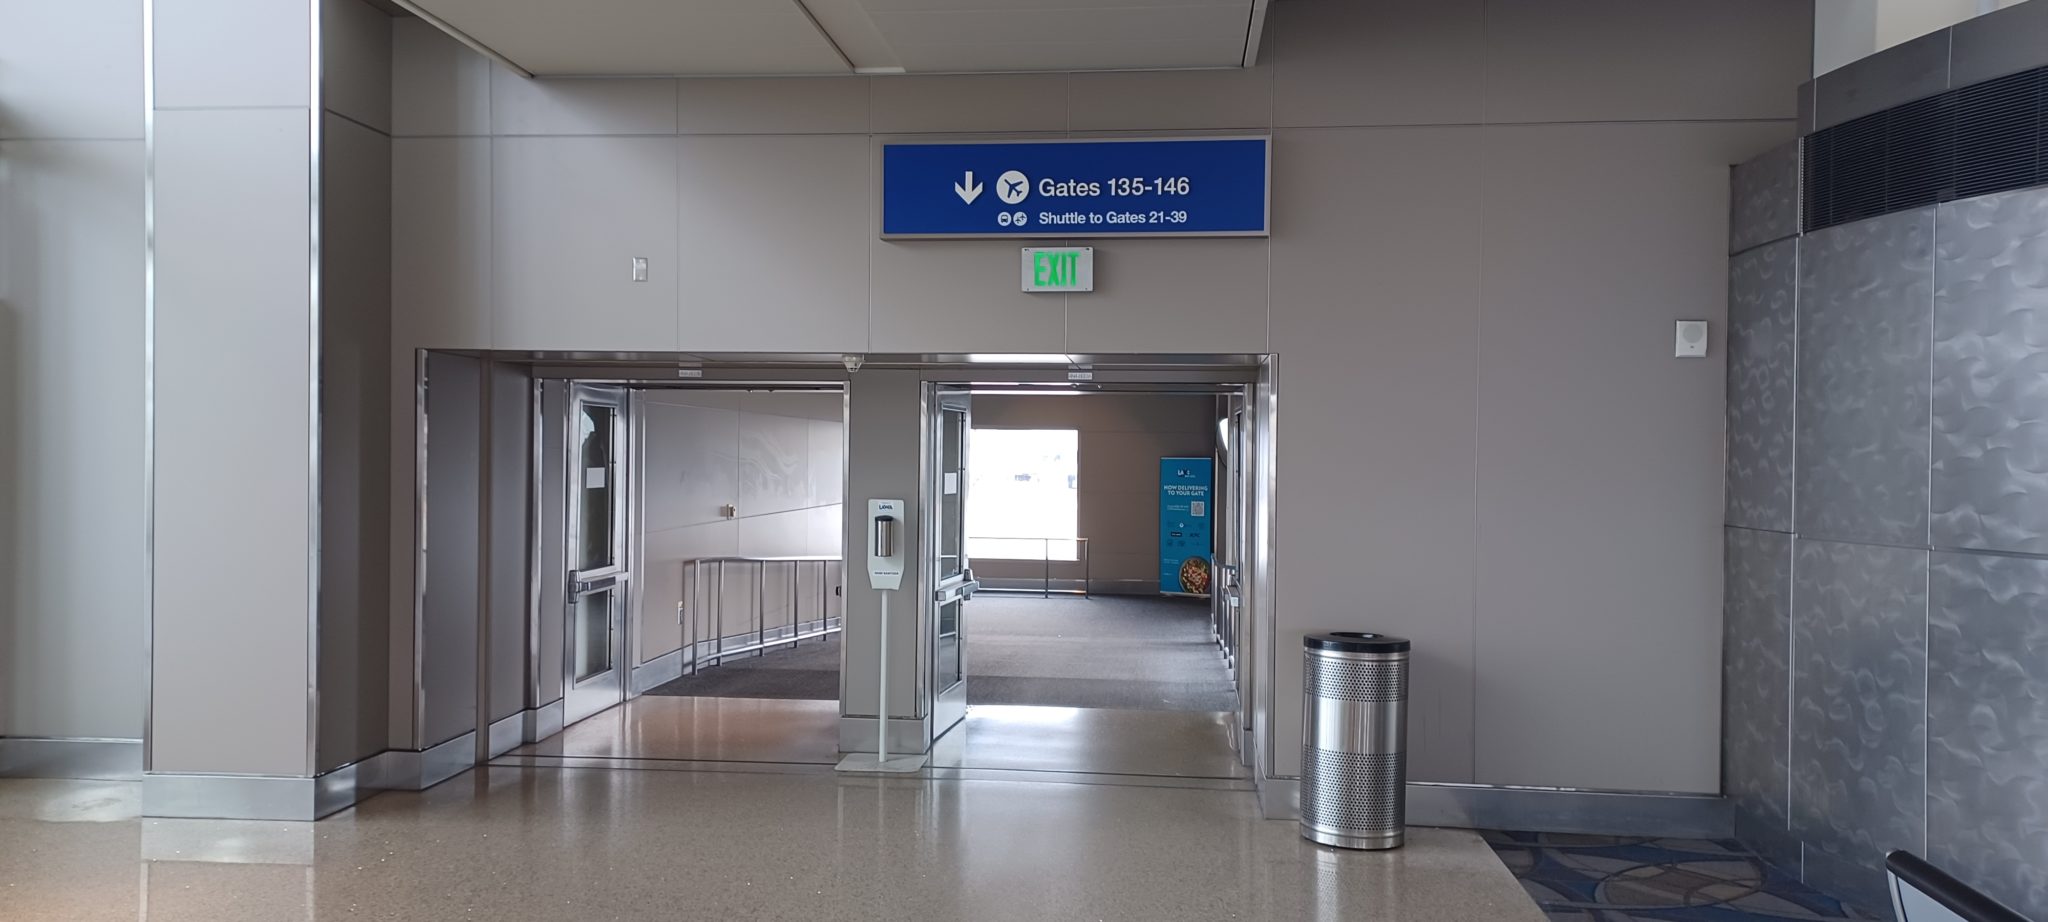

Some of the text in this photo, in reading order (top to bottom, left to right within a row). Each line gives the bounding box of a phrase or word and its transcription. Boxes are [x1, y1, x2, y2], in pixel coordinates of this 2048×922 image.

[1038, 176, 1190, 196] Gates 135-146
[1038, 211, 1188, 224] Shuttle to Gates 21-39
[1033, 251, 1079, 287] EXIT
